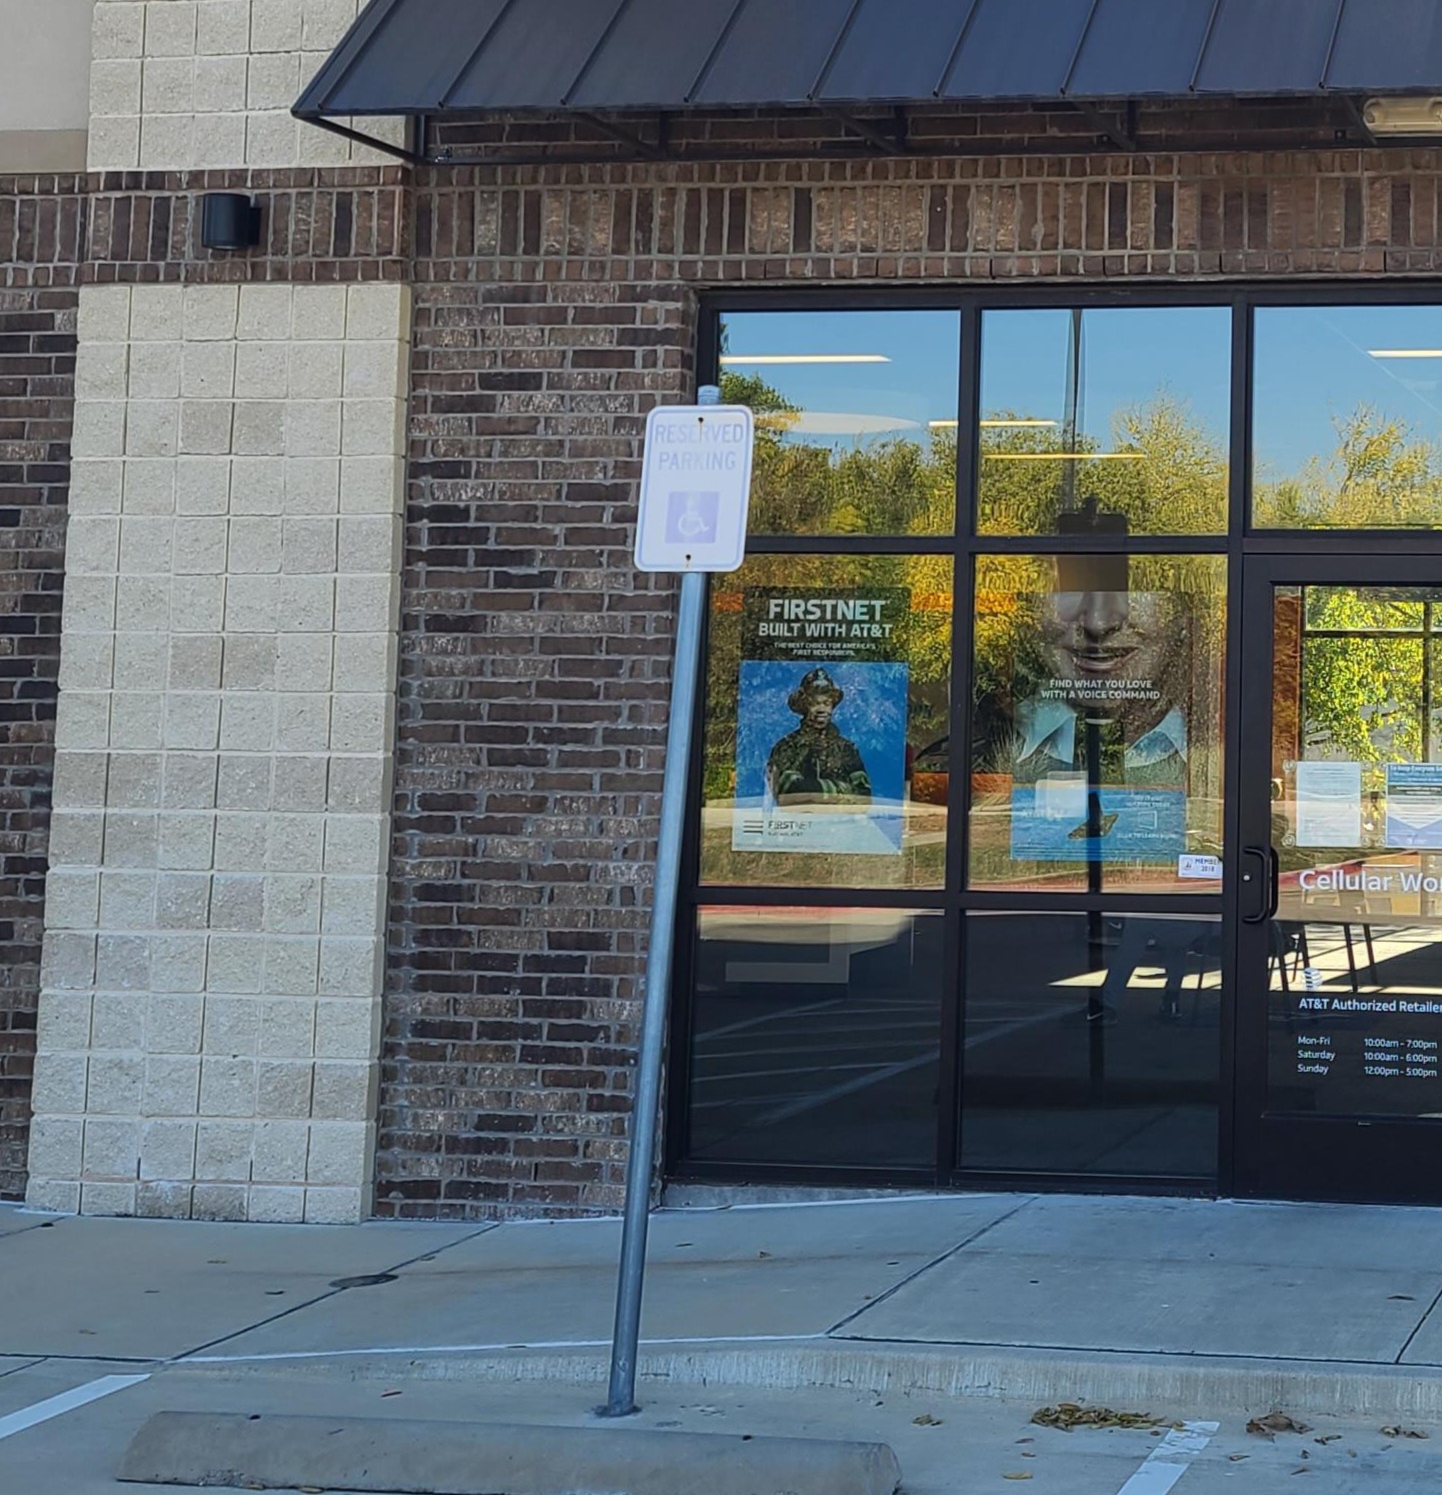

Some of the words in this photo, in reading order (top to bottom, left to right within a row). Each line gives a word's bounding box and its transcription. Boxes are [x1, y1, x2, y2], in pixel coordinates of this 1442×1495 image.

[655, 423, 744, 444] RESERVED
[659, 451, 736, 470] PARKING
[769, 599, 886, 621] FIRSTNET
[759, 623, 800, 636] BUILT
[805, 623, 846, 637] WITH
[850, 624, 893, 638] AT&T
[1049, 679, 1072, 688] FIND
[1074, 680, 1104, 688] WHAT
[1105, 680, 1125, 688] YOU
[1127, 680, 1153, 689] LOVE
[1041, 690, 1067, 698] WITH
[1068, 690, 1076, 699] A
[1078, 690, 1107, 699] VOICE
[1109, 690, 1161, 700] COMMAND
[1299, 870, 1393, 892] Cellular
[1299, 998, 1329, 1010] AT&T
[1331, 999, 1397, 1011] Authorized
[1298, 1036, 1331, 1045] Mon-Fri
[1364, 1038, 1399, 1047] 10:00am
[1298, 1050, 1335, 1061] Saturday
[1364, 1052, 1399, 1062] 10:00am
[1298, 1064, 1329, 1075] Sunday
[1364, 1066, 1399, 1077] 12:00pm
